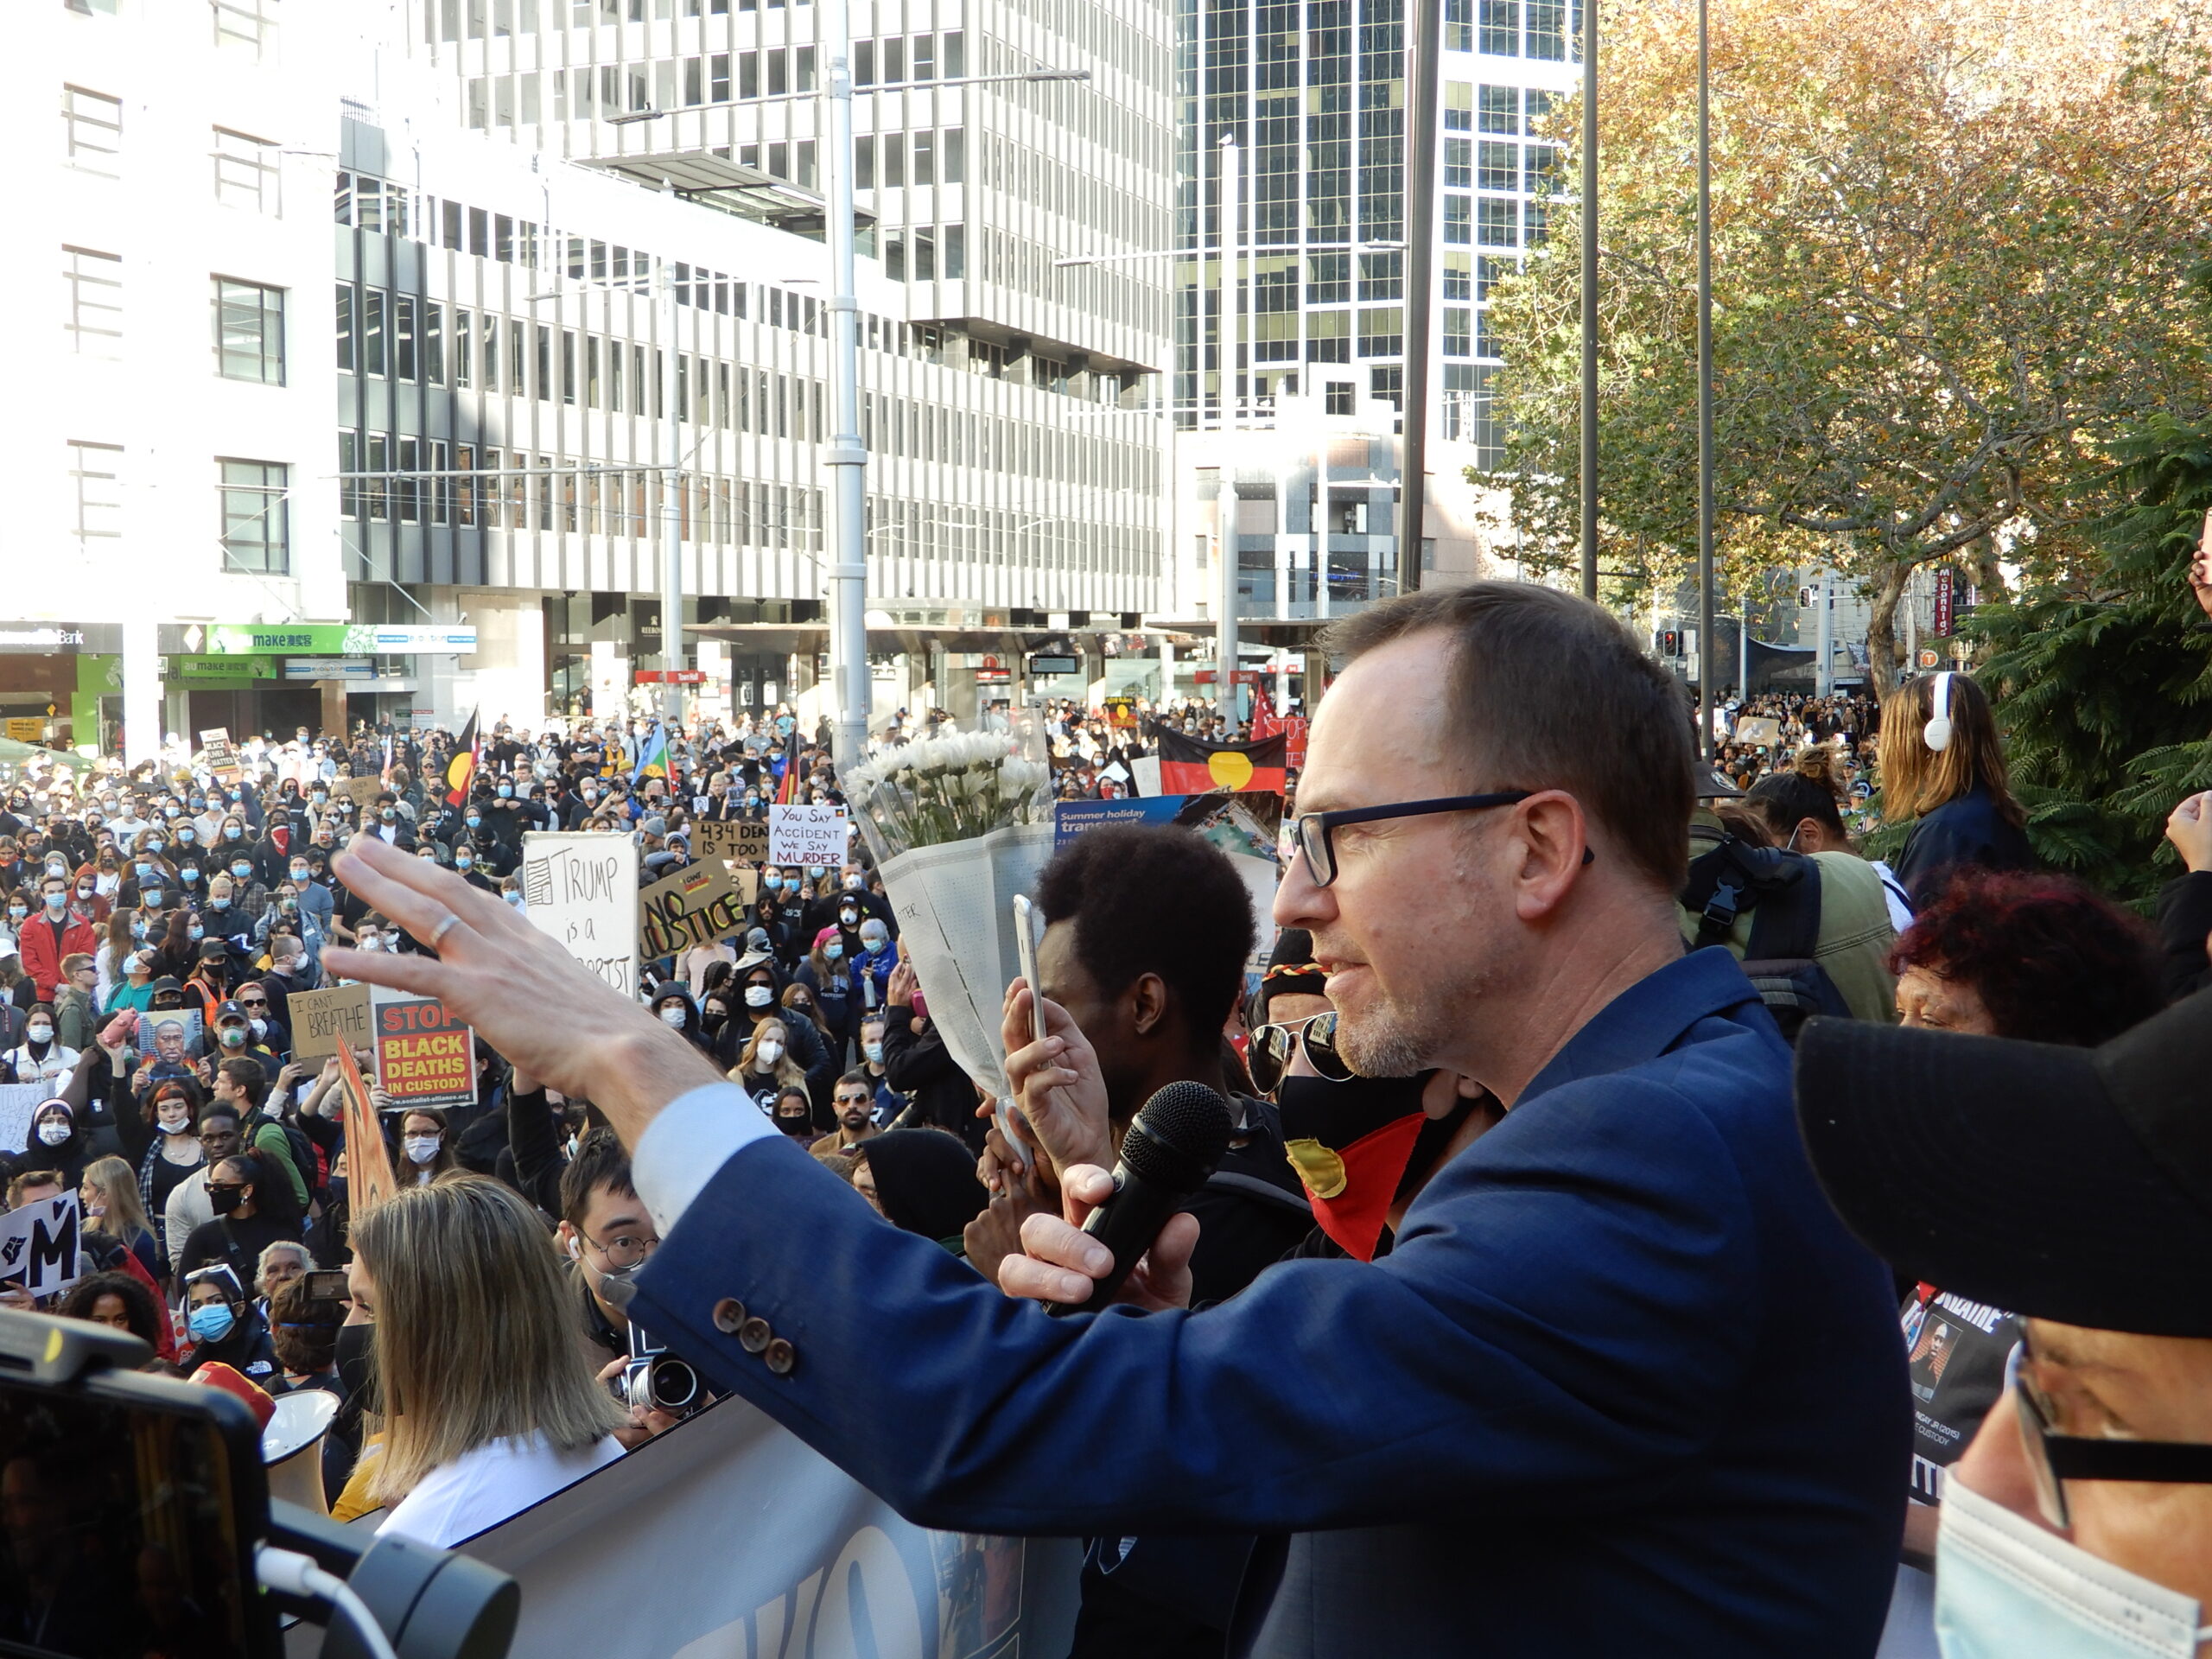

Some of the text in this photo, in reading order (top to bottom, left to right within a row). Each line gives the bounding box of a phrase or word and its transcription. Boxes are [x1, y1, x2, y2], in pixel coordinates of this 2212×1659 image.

[1939, 568, 1950, 637] McDonald's
[1267, 718, 1306, 740] STOP
[206, 741, 225, 751] BLACK
[208, 750, 225, 759] LIVES
[211, 757, 234, 767] MATTER
[1060, 809, 1146, 821] Summer holiday
[701, 823, 734, 842] 434
[702, 840, 715, 855] IS
[728, 842, 758, 856] TOO
[778, 851, 841, 865] MURDER
[550, 847, 618, 904] TRUMP
[566, 918, 578, 943] is
[385, 1034, 464, 1059] BLACK
[386, 1057, 466, 1079] DEATHS
[388, 1077, 467, 1094] IN CUSTODY
[1918, 1424, 1950, 1446] CUSTODY
[1939, 1424, 1961, 1440] (2015)
